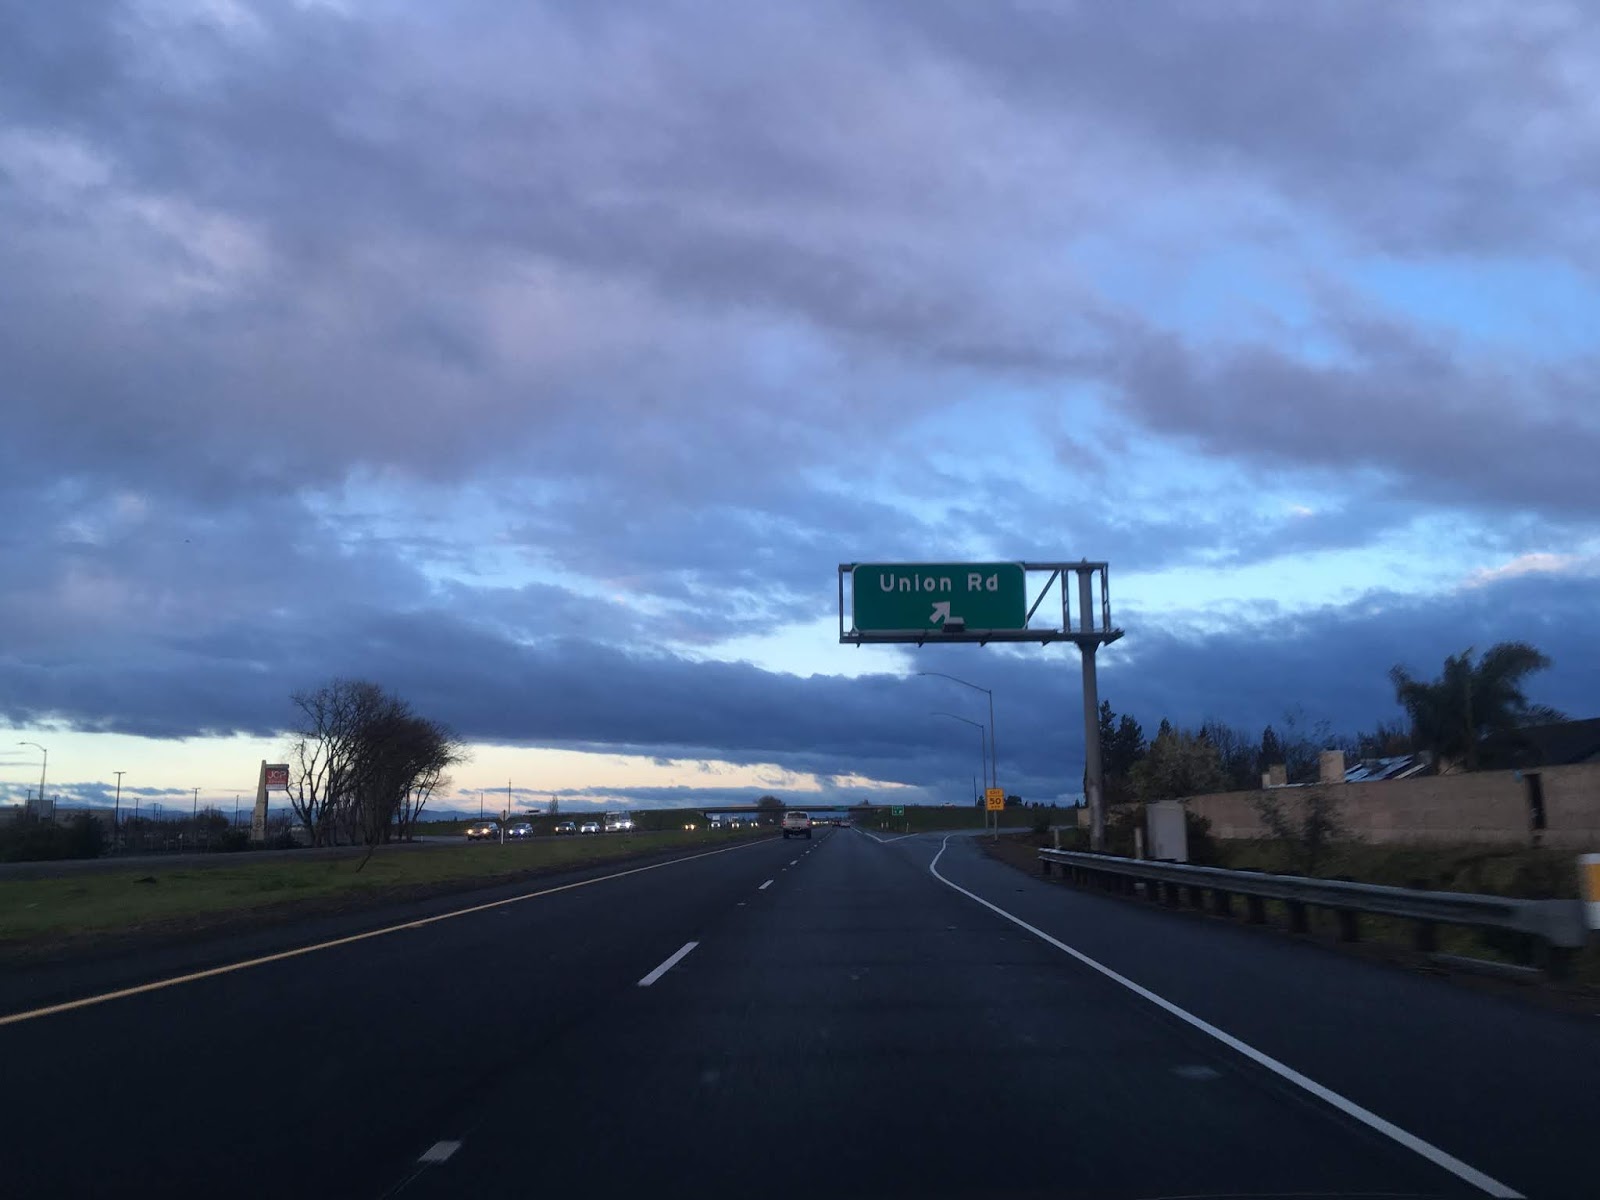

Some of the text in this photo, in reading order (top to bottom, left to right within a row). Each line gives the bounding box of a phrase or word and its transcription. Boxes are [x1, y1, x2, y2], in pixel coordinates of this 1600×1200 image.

[880, 573, 998, 592] Union Rd
[989, 797, 1001, 805] 50
